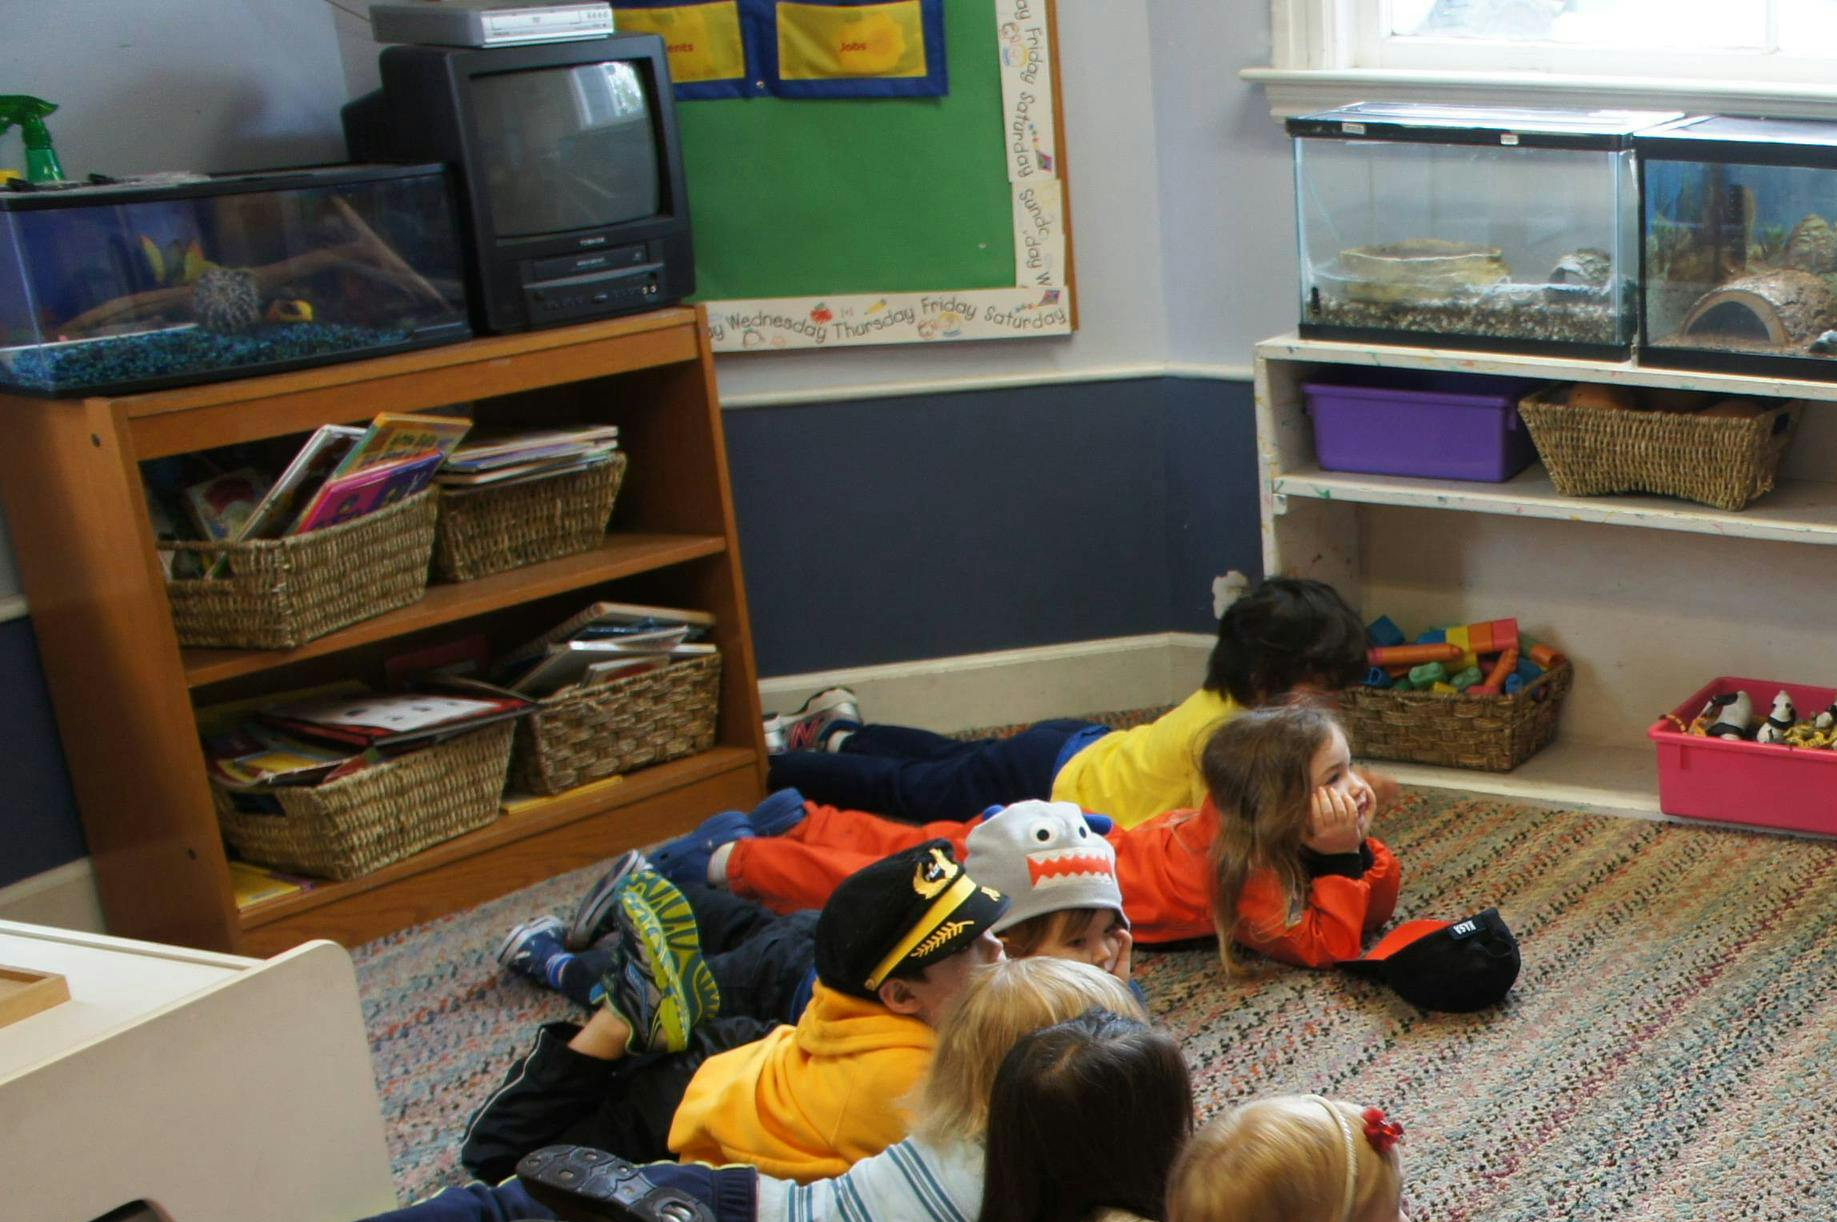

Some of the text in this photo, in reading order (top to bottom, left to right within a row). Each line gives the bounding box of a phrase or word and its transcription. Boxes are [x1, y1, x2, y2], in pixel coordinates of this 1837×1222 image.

[840, 42, 866, 52] Jobs
[1020, 27, 1043, 85] Friday
[1012, 92, 1035, 178] Saturday
[725, 309, 829, 344] Wednesday
[832, 306, 915, 340] Thursday
[920, 296, 978, 322] Friday
[984, 304, 1067, 330] Saturday
